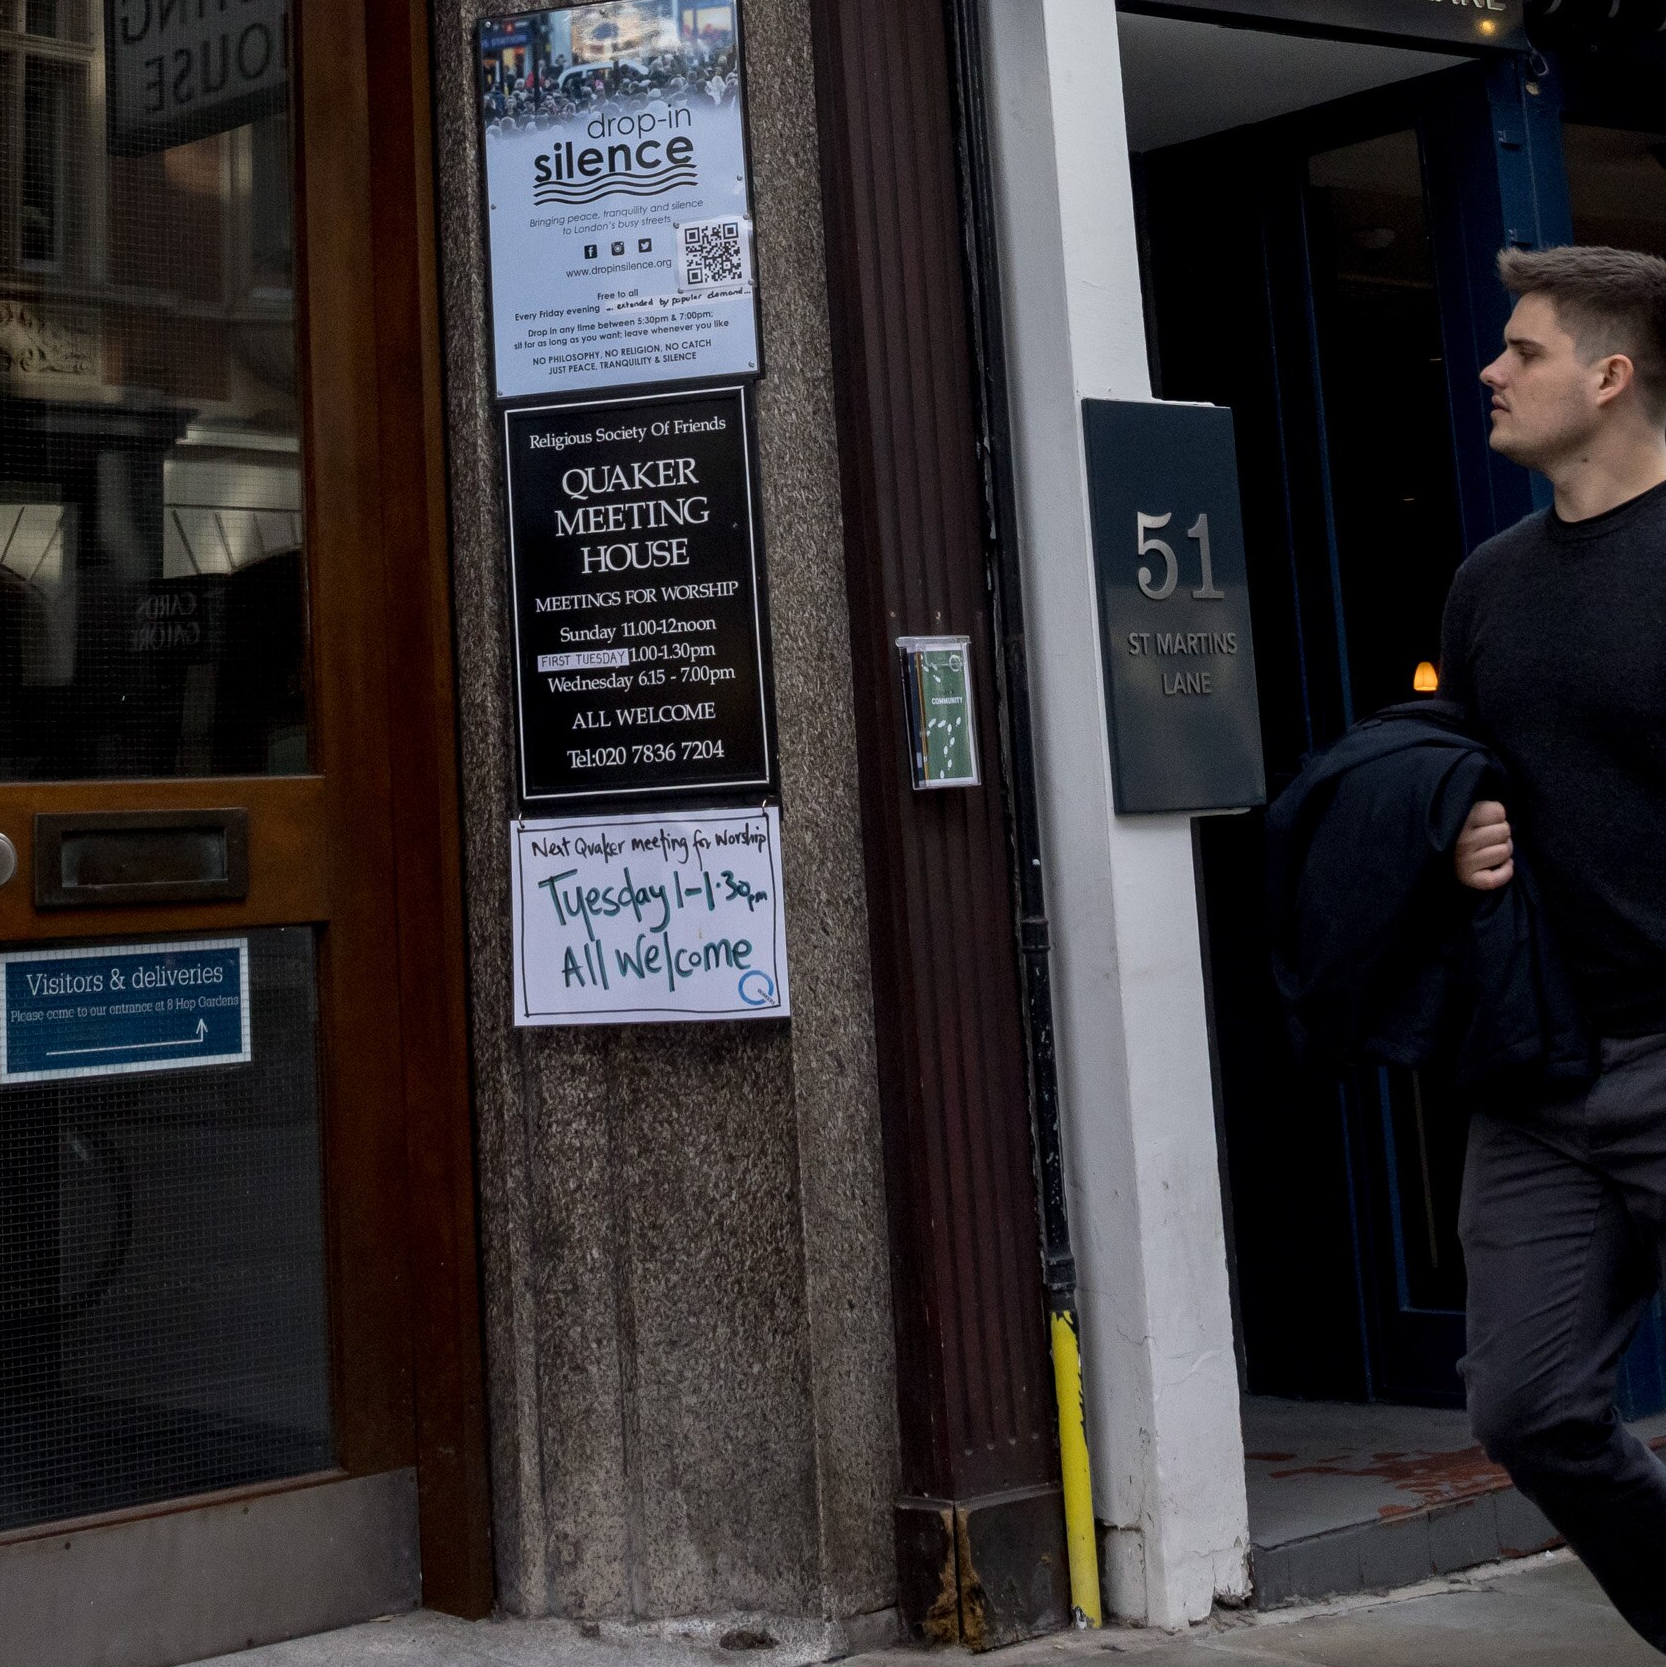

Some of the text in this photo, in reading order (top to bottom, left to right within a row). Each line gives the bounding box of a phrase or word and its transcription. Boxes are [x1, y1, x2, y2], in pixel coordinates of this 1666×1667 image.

[587, 103, 692, 139] drop-in
[534, 136, 694, 183] silence
[529, 199, 704, 228] Bringing peace, tranquility and silence
[563, 215, 672, 236] to London's busy streets
[565, 259, 672, 278] www.dropinsilence.org
[597, 288, 639, 300] Free to all
[617, 297, 654, 310] extended
[659, 298, 669, 308] by
[515, 305, 600, 321] Every Friday evening
[528, 329, 548, 338] Drop
[549, 327, 557, 335] in
[559, 325, 575, 335] any
[577, 323, 596, 331] time
[598, 318, 635, 330] between
[637, 315, 669, 326] 5:30pm
[671, 314, 677, 322] &
[514, 341, 523, 350] sit
[524, 340, 535, 349] for
[537, 339, 547, 347] as
[549, 337, 568, 347] long
[570, 336, 579, 344] as
[581, 334, 597, 344] you
[624, 327, 649, 337] leave
[651, 323, 693, 335] whenever
[695, 321, 712, 332] you
[714, 319, 729, 328] like
[533, 338, 712, 366] NO PHILOSOPHY, NO RELIGION, NO CATCH
[548, 352, 697, 375] JUST PEACE, TRANQUILITY & SILENCE
[529, 416, 727, 450] Religious Society Of Friends
[561, 457, 699, 500] QUAKER
[554, 496, 710, 537] MEETING
[580, 537, 690, 574] HOUSE
[1136, 511, 1225, 600] 51
[535, 581, 739, 613] MEETINGS FOR WORSHIP
[560, 617, 717, 644] Sunday 11.00-12noon
[1128, 632, 1238, 656] ST MARTINS
[540, 642, 717, 668] FIRST TUESDAY 1.00-1.30pm
[547, 672, 634, 694] Wednesday
[638, 668, 666, 686] 6.15
[680, 664, 736, 687] 7.00pm
[1162, 672, 1213, 695] LANE
[572, 702, 717, 730] ALL WELCOME
[567, 739, 724, 769] Tel:020 7836 7204
[532, 836, 571, 858] Next
[574, 832, 626, 864] Quaker
[631, 827, 689, 865] meeting
[693, 829, 712, 872] for
[538, 866, 671, 942] Tuesday
[562, 938, 609, 991] All
[26, 962, 224, 997] Visitors & deliveries
[10, 995, 239, 1023] Please come to our entrance at 8 Hop Gardens
